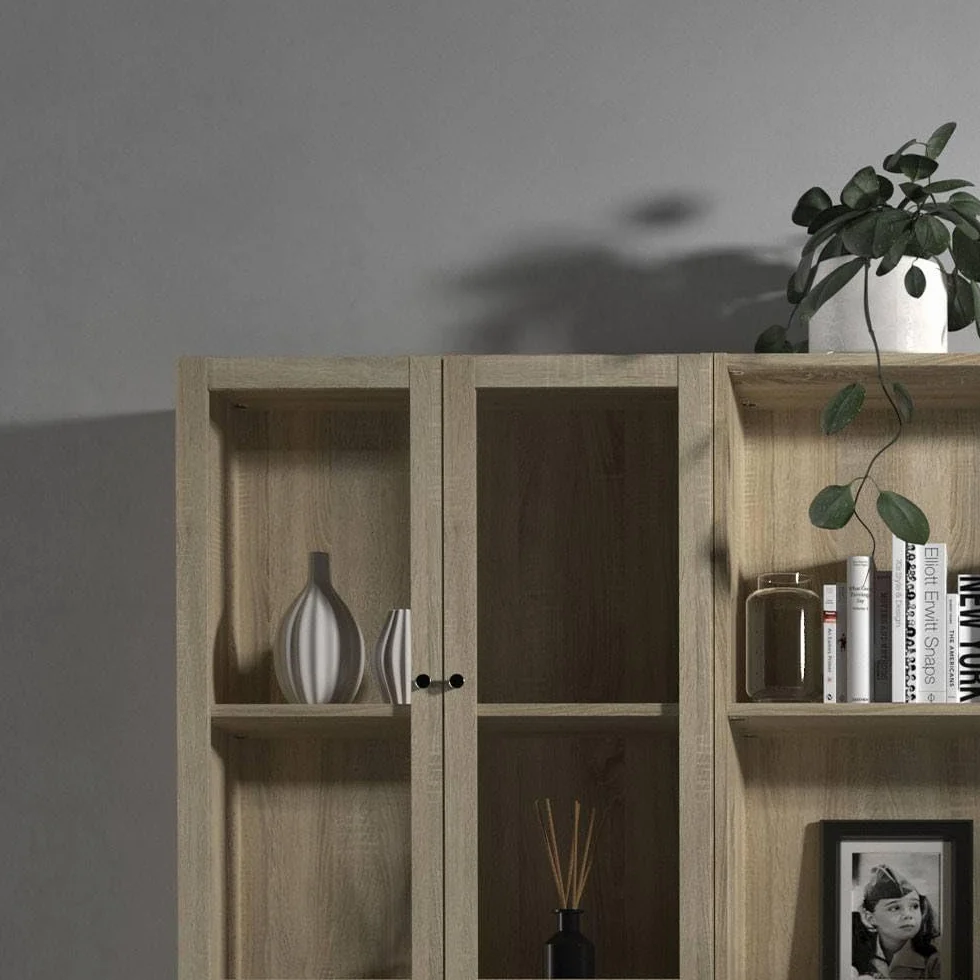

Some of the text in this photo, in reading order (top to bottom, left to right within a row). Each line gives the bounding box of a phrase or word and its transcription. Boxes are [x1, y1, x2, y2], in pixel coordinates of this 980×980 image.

[893, 600, 902, 628] Design
[922, 547, 939, 685] Elliott Erwitt Snaps
